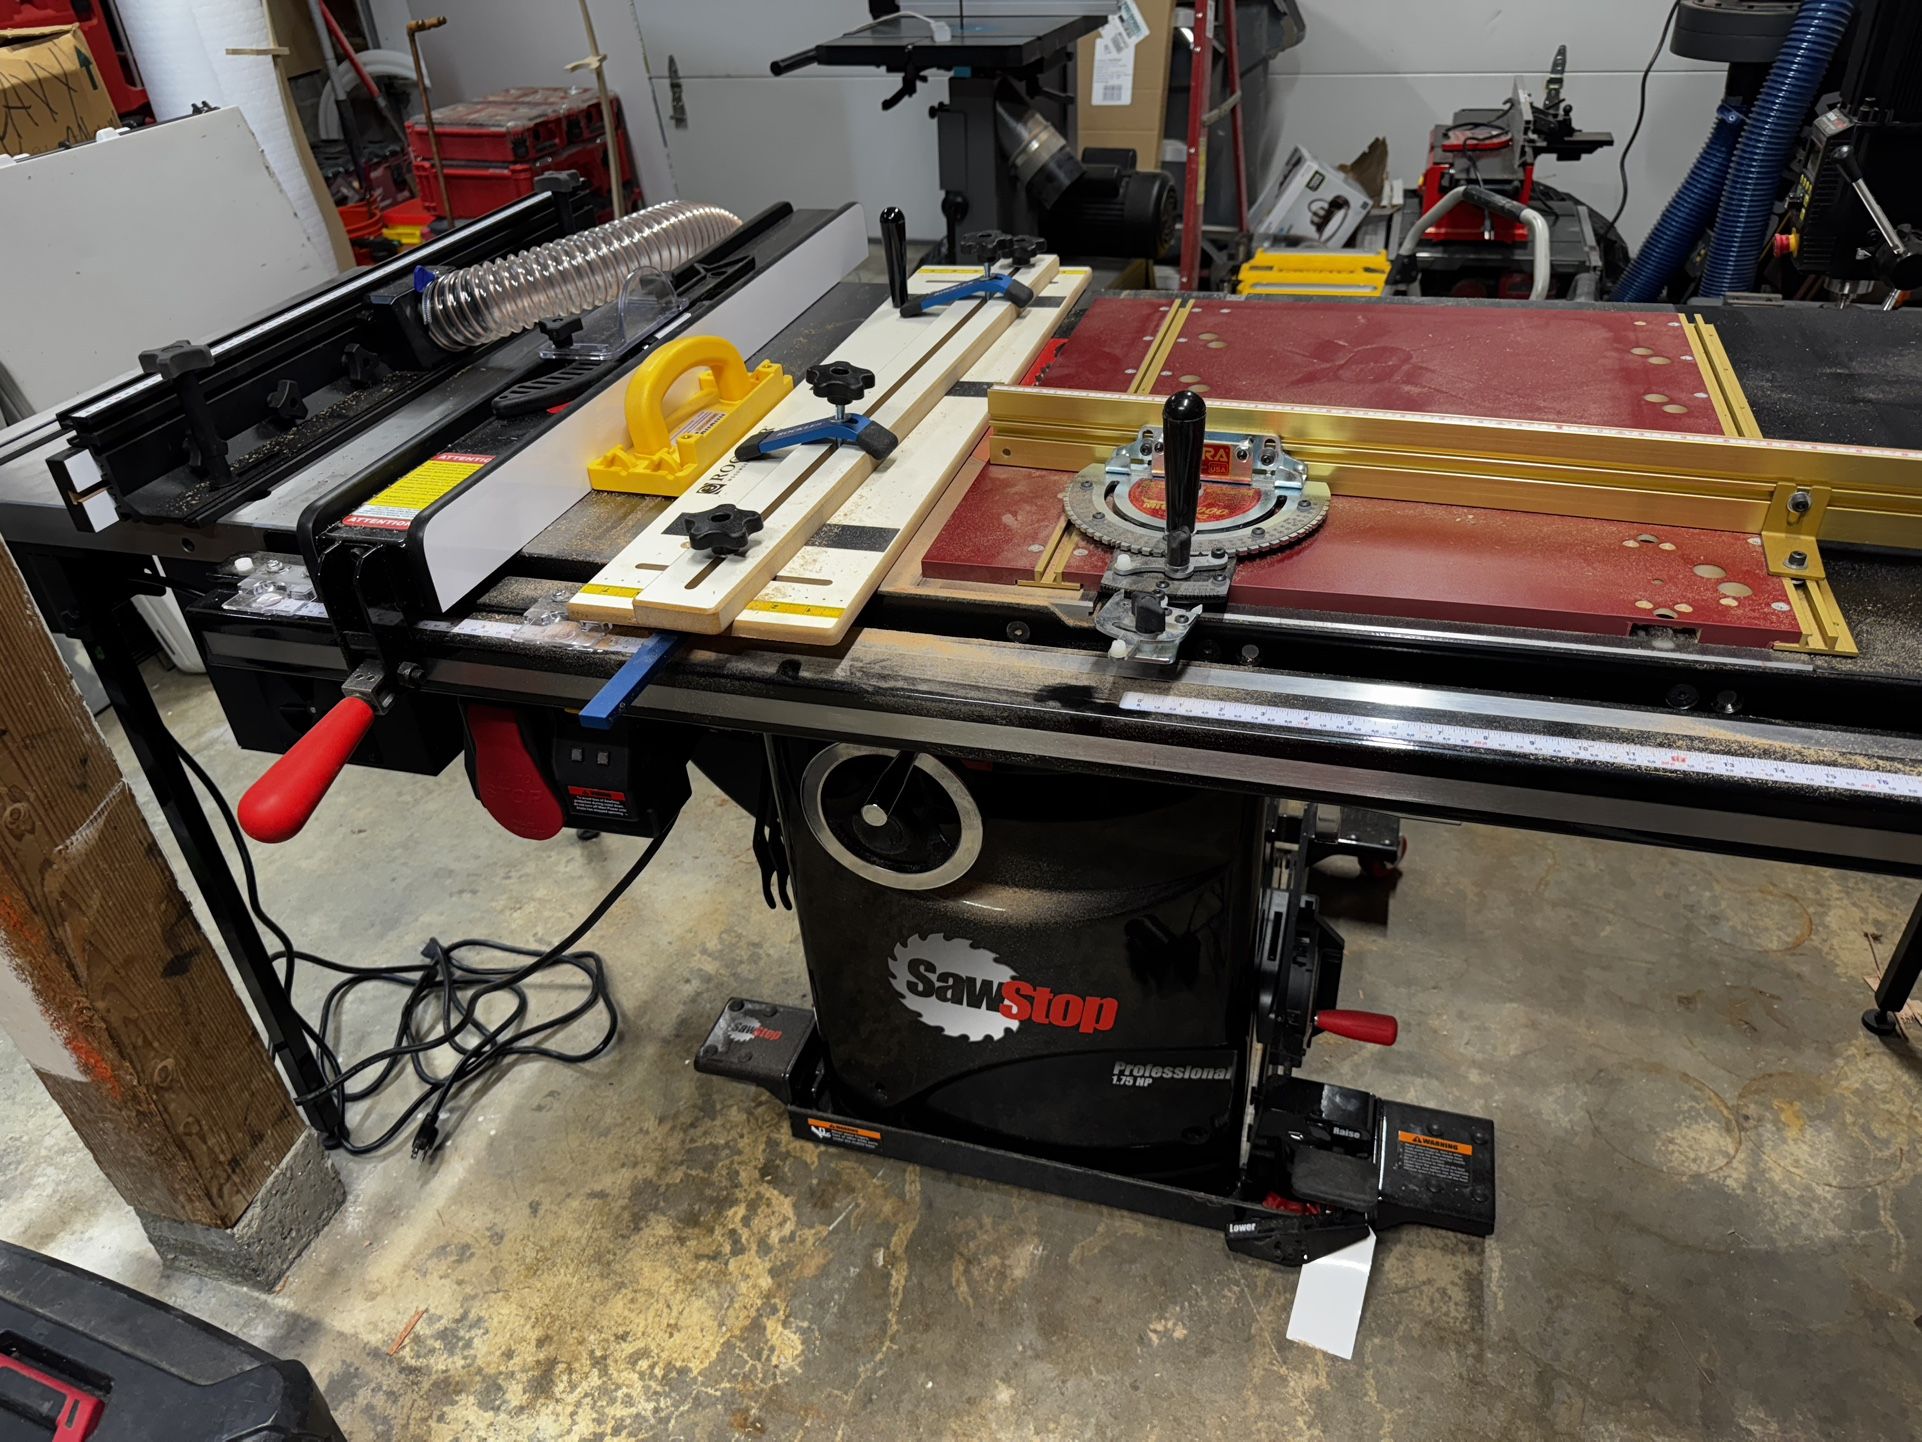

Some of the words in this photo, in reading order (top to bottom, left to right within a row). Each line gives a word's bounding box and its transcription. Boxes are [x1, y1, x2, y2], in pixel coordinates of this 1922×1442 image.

[905, 956, 1119, 1035] SawStop
[1112, 1060, 1234, 1081] Professional
[1111, 1074, 1134, 1087] 1.75
[1134, 1076, 1154, 1088] HP
[1332, 1126, 1361, 1140] Raise
[1422, 1136, 1460, 1151] WARNING
[1228, 1221, 1257, 1234] Lower
